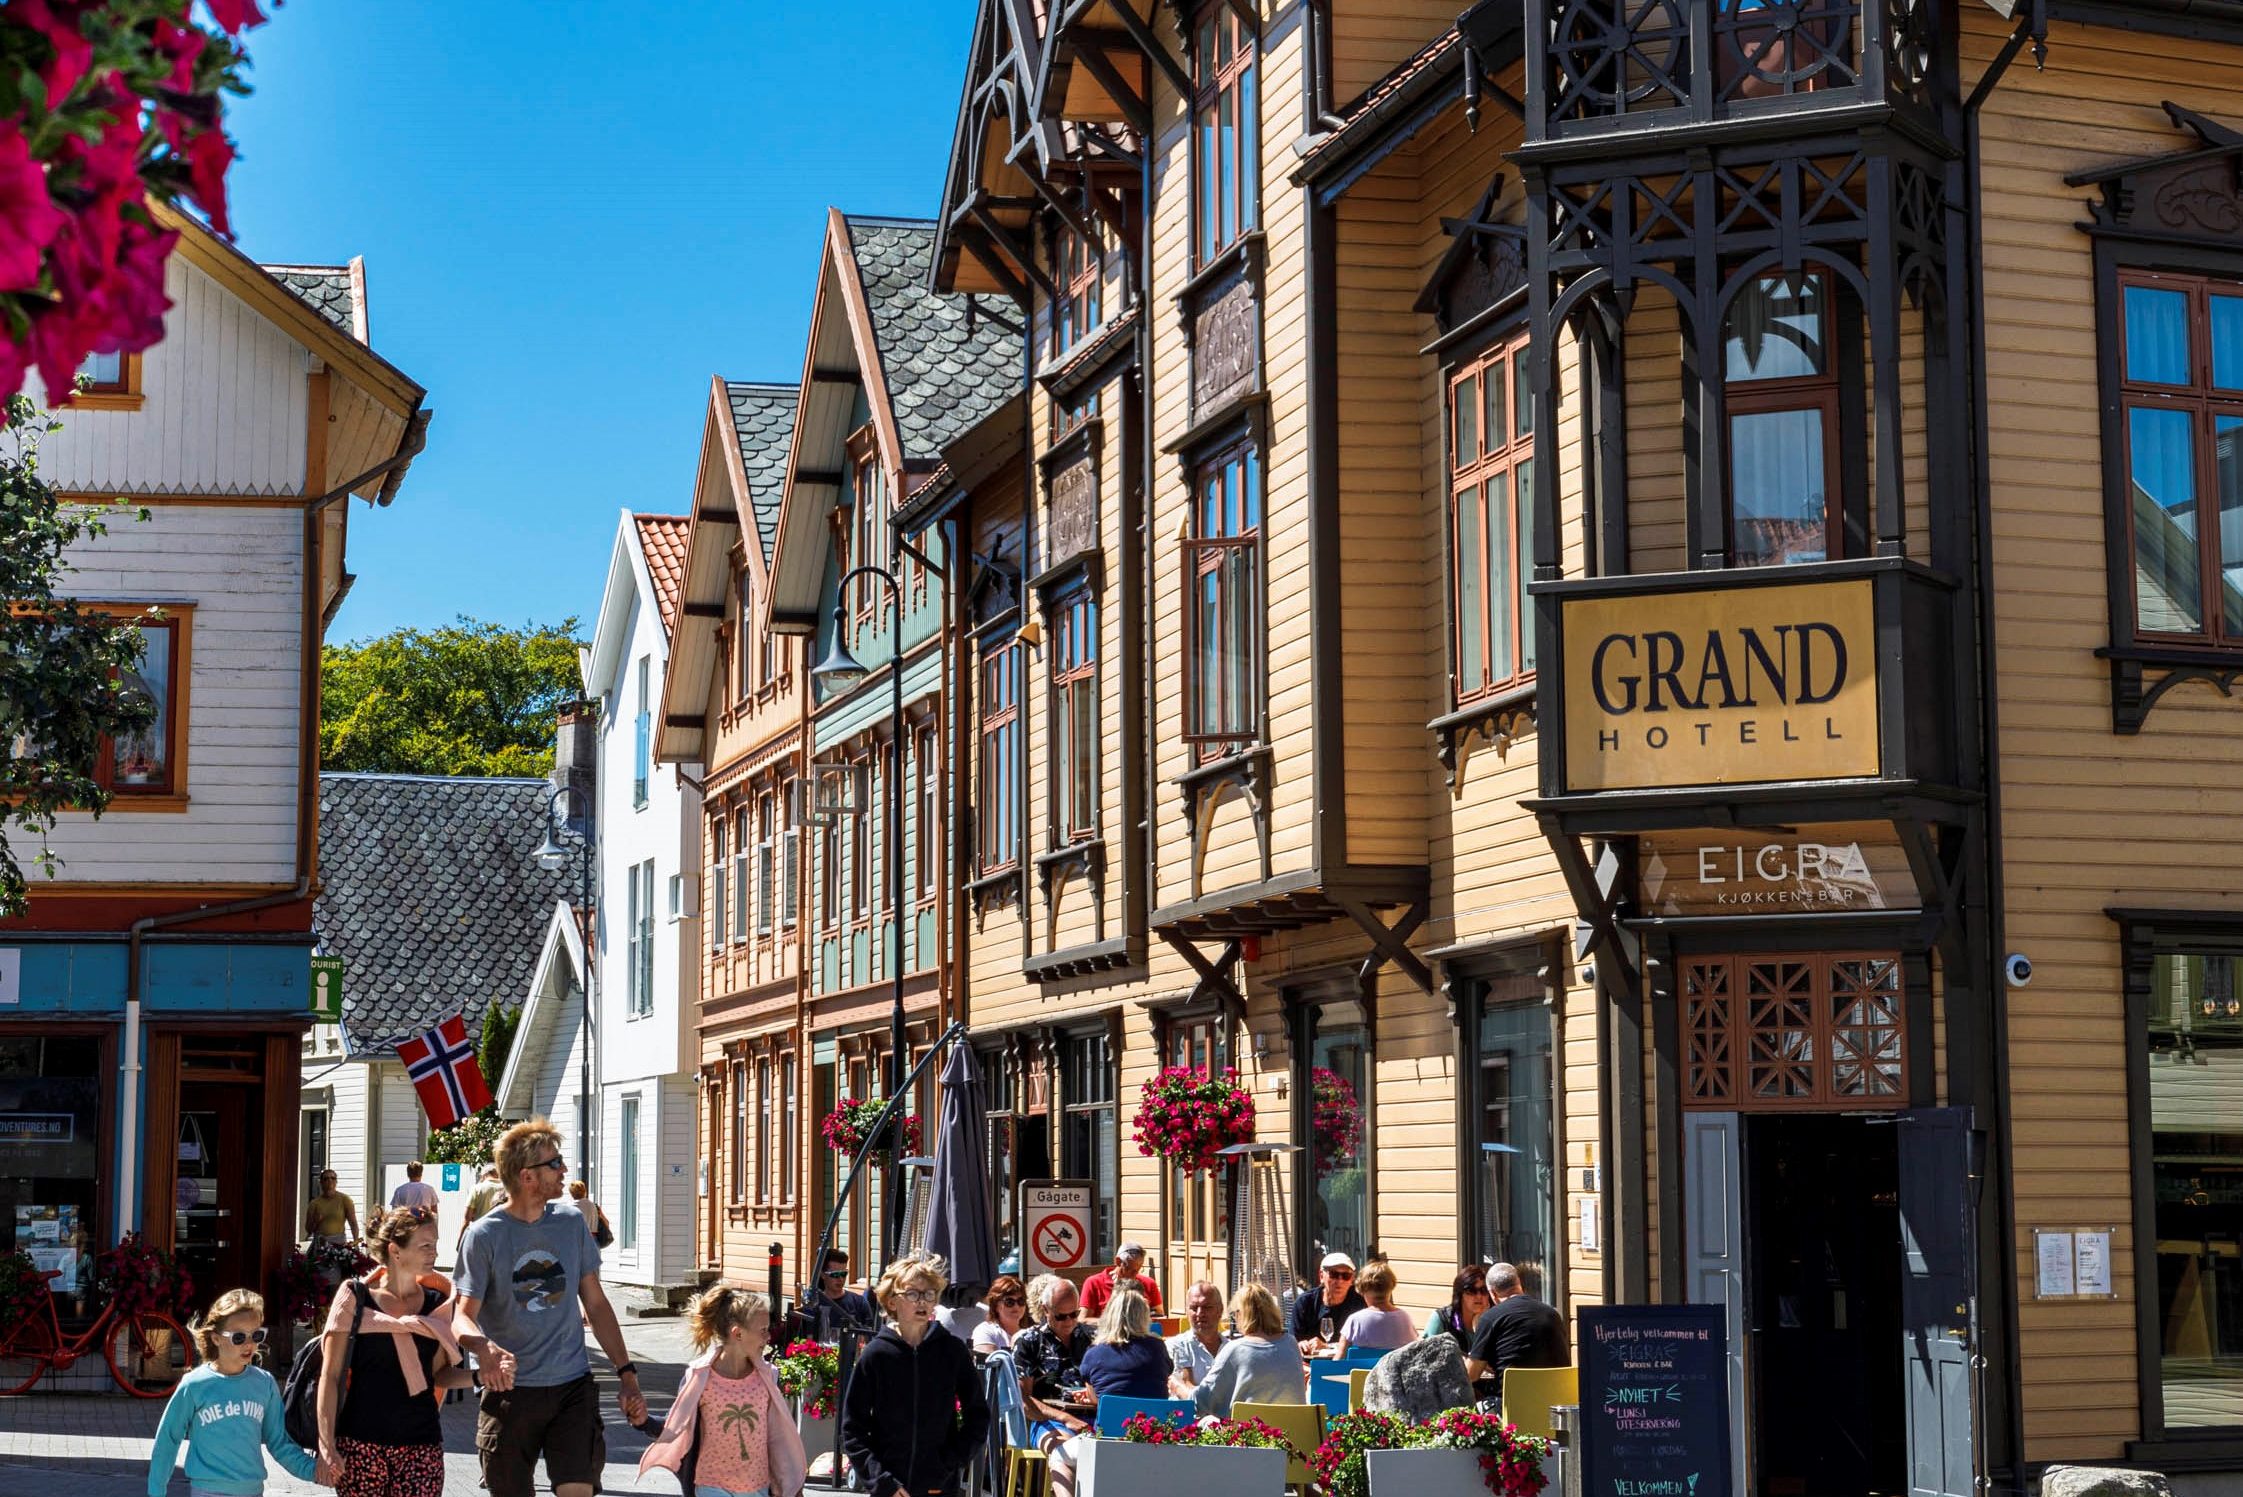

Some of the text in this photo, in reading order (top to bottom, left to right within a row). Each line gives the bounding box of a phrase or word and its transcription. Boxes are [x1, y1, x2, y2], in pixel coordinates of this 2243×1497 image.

[1591, 622, 1848, 716] GRAND
[1600, 717, 1842, 751] HOTELL
[1699, 842, 1873, 884] EIGRA
[1718, 890, 1801, 905] KJØKKEN
[1037, 1190, 1081, 1204] Gågate
[1697, 1329, 1709, 1341] til
[1619, 1388, 1663, 1403] NYHET
[198, 1403, 225, 1427] JOIE
[225, 1400, 240, 1417] de
